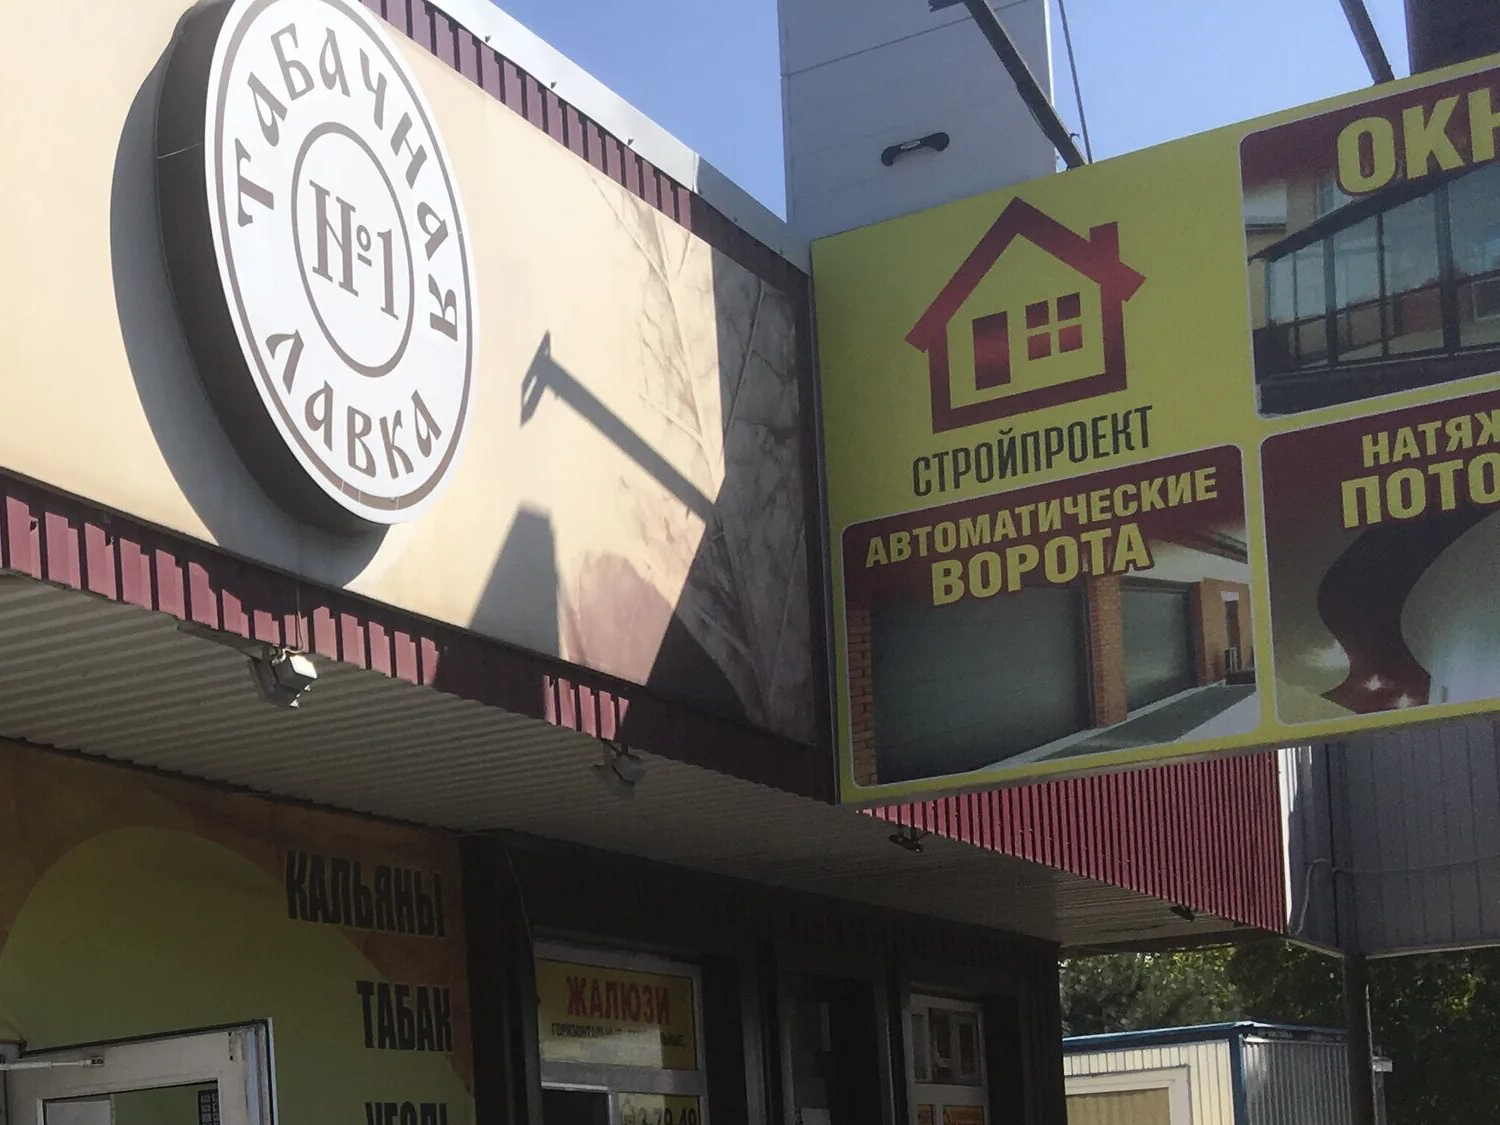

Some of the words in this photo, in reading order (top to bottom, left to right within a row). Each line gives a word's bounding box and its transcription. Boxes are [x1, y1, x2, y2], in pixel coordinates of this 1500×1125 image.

[911, 405, 1153, 497] СТРОЙПРОЕКТ
[865, 465, 1218, 568] АВТОМАТИЧЕСКИЕ
[931, 524, 1153, 606] ВОРОТА
[285, 849, 446, 938] КАЛЬЯНЫ
[356, 981, 454, 1054] ТАБАК
[566, 975, 670, 1025] ЖАЛЮЗИ
